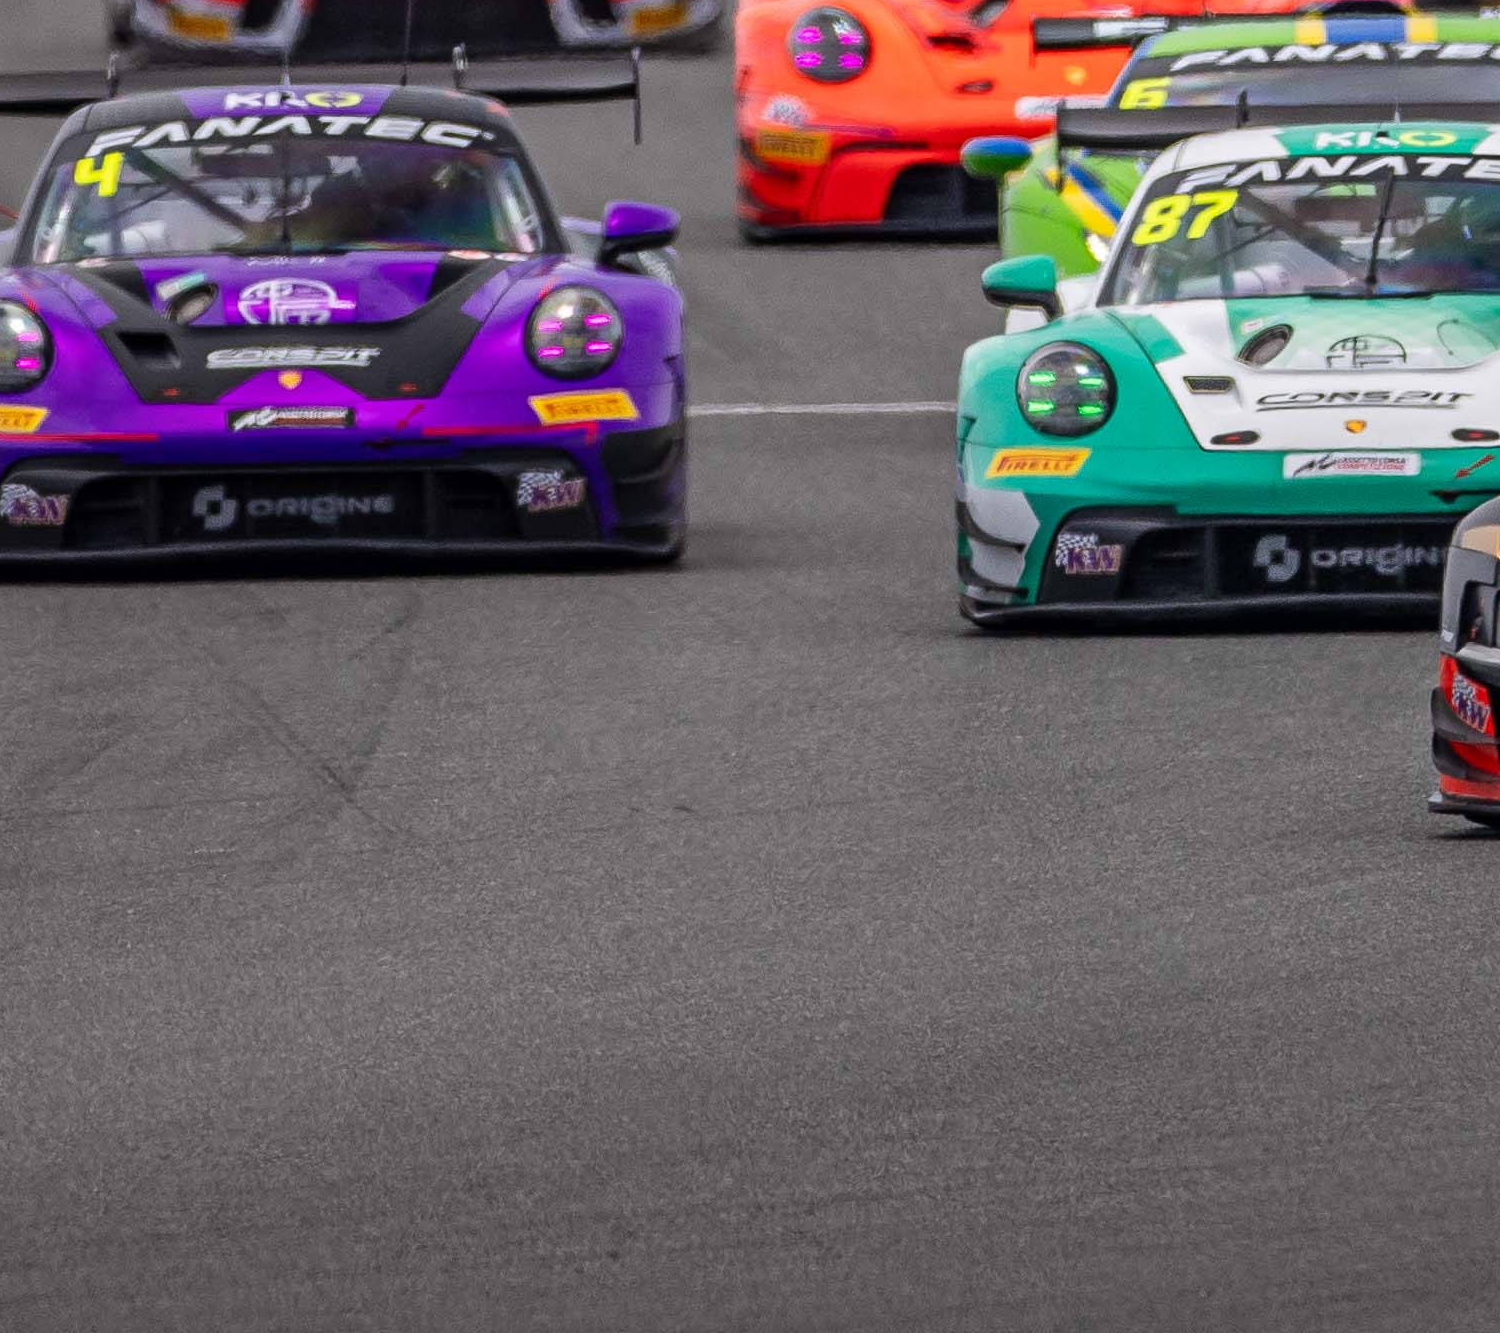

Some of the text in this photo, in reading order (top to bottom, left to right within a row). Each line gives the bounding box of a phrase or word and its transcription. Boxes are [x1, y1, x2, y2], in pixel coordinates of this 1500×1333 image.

[84, 114, 488, 158] FANATEC
[73, 150, 127, 198] 4
[1131, 189, 1240, 247] 87
[1256, 390, 1475, 406] CONSPIT
[996, 453, 1081, 474] PIRELLI
[246, 493, 396, 525] ORIGINE
[1309, 543, 1447, 576] ORIGIN
